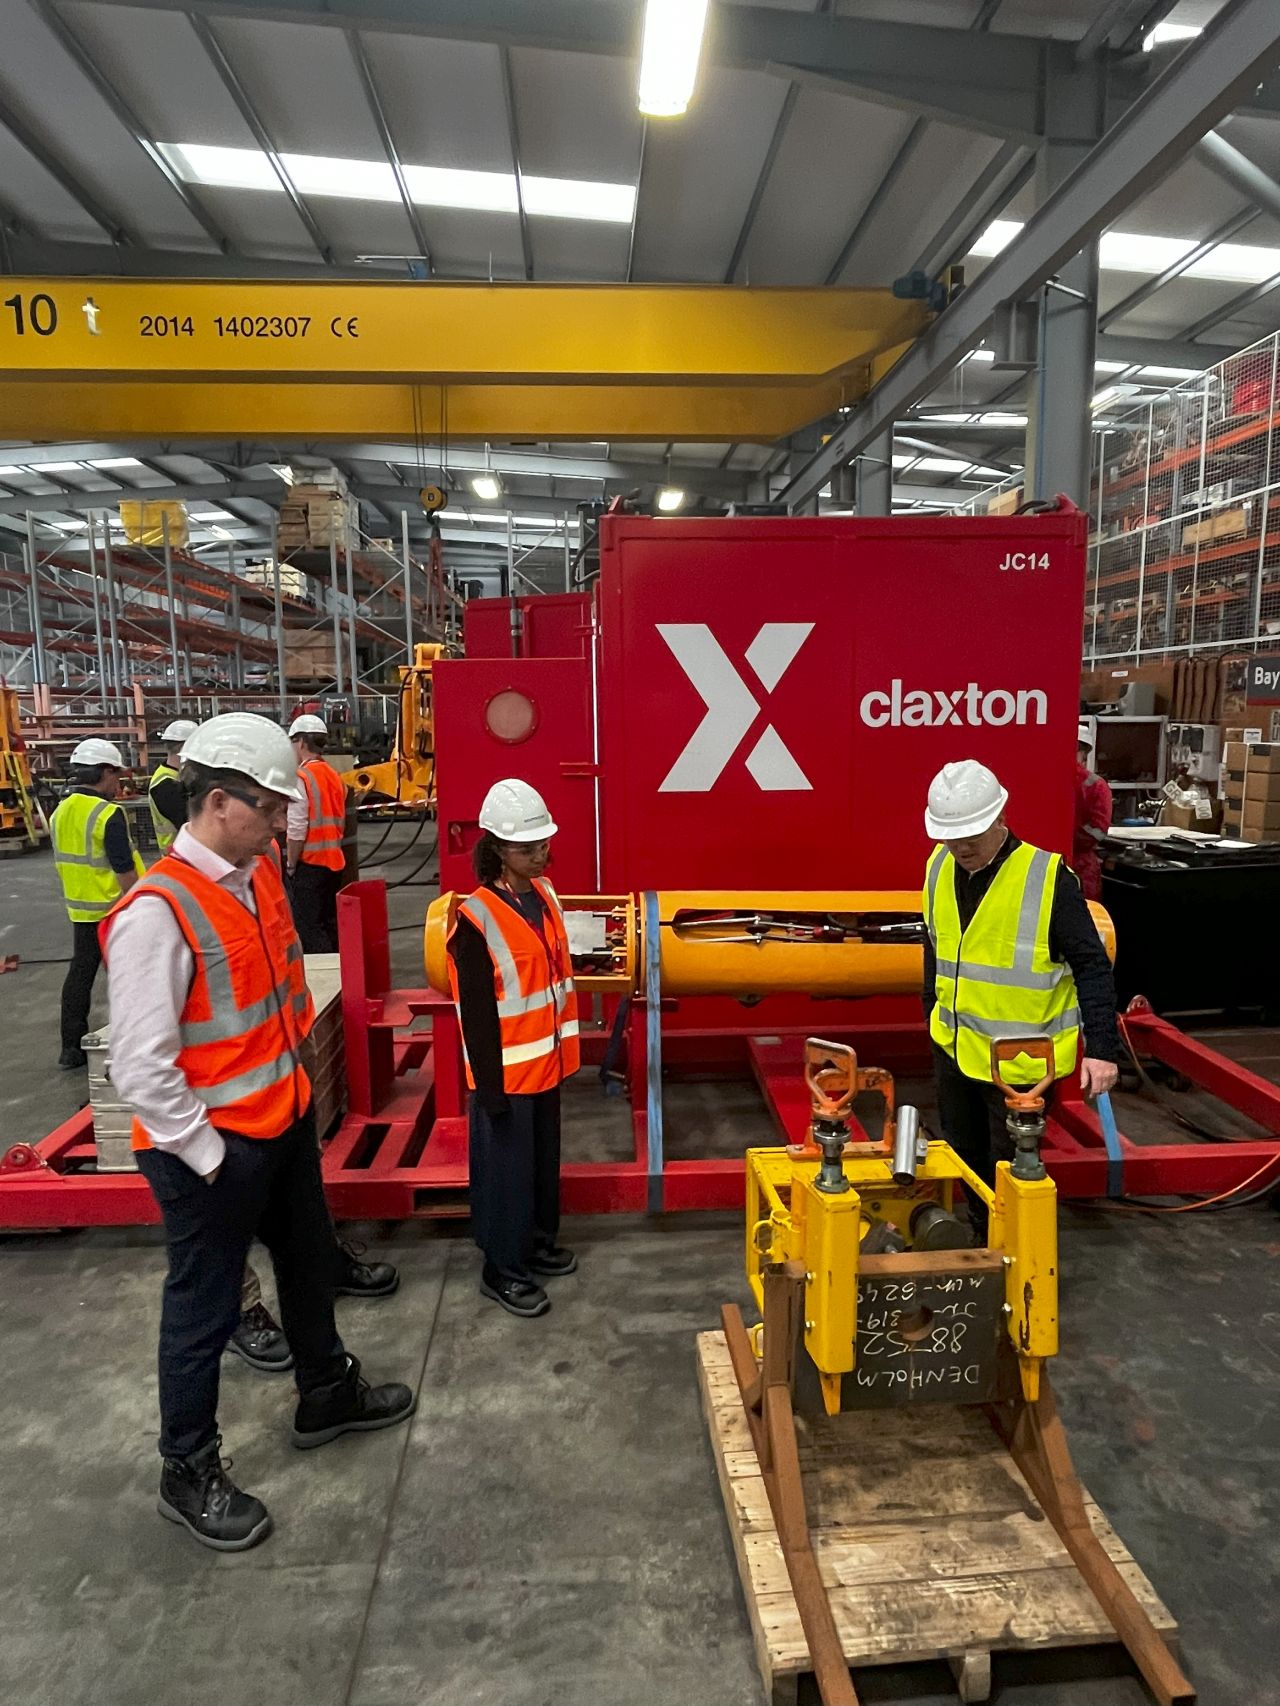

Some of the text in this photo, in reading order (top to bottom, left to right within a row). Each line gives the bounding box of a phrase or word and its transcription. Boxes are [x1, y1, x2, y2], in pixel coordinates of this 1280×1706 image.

[4, 293, 58, 336] 10
[82, 296, 101, 336] t
[139, 316, 195, 337] 2014
[213, 316, 312, 337] 1402307
[999, 552, 1050, 571] JC14
[1254, 666, 1280, 690] Bay
[859, 678, 1048, 728] claxton
[857, 1364, 981, 1389] DENHOLM
